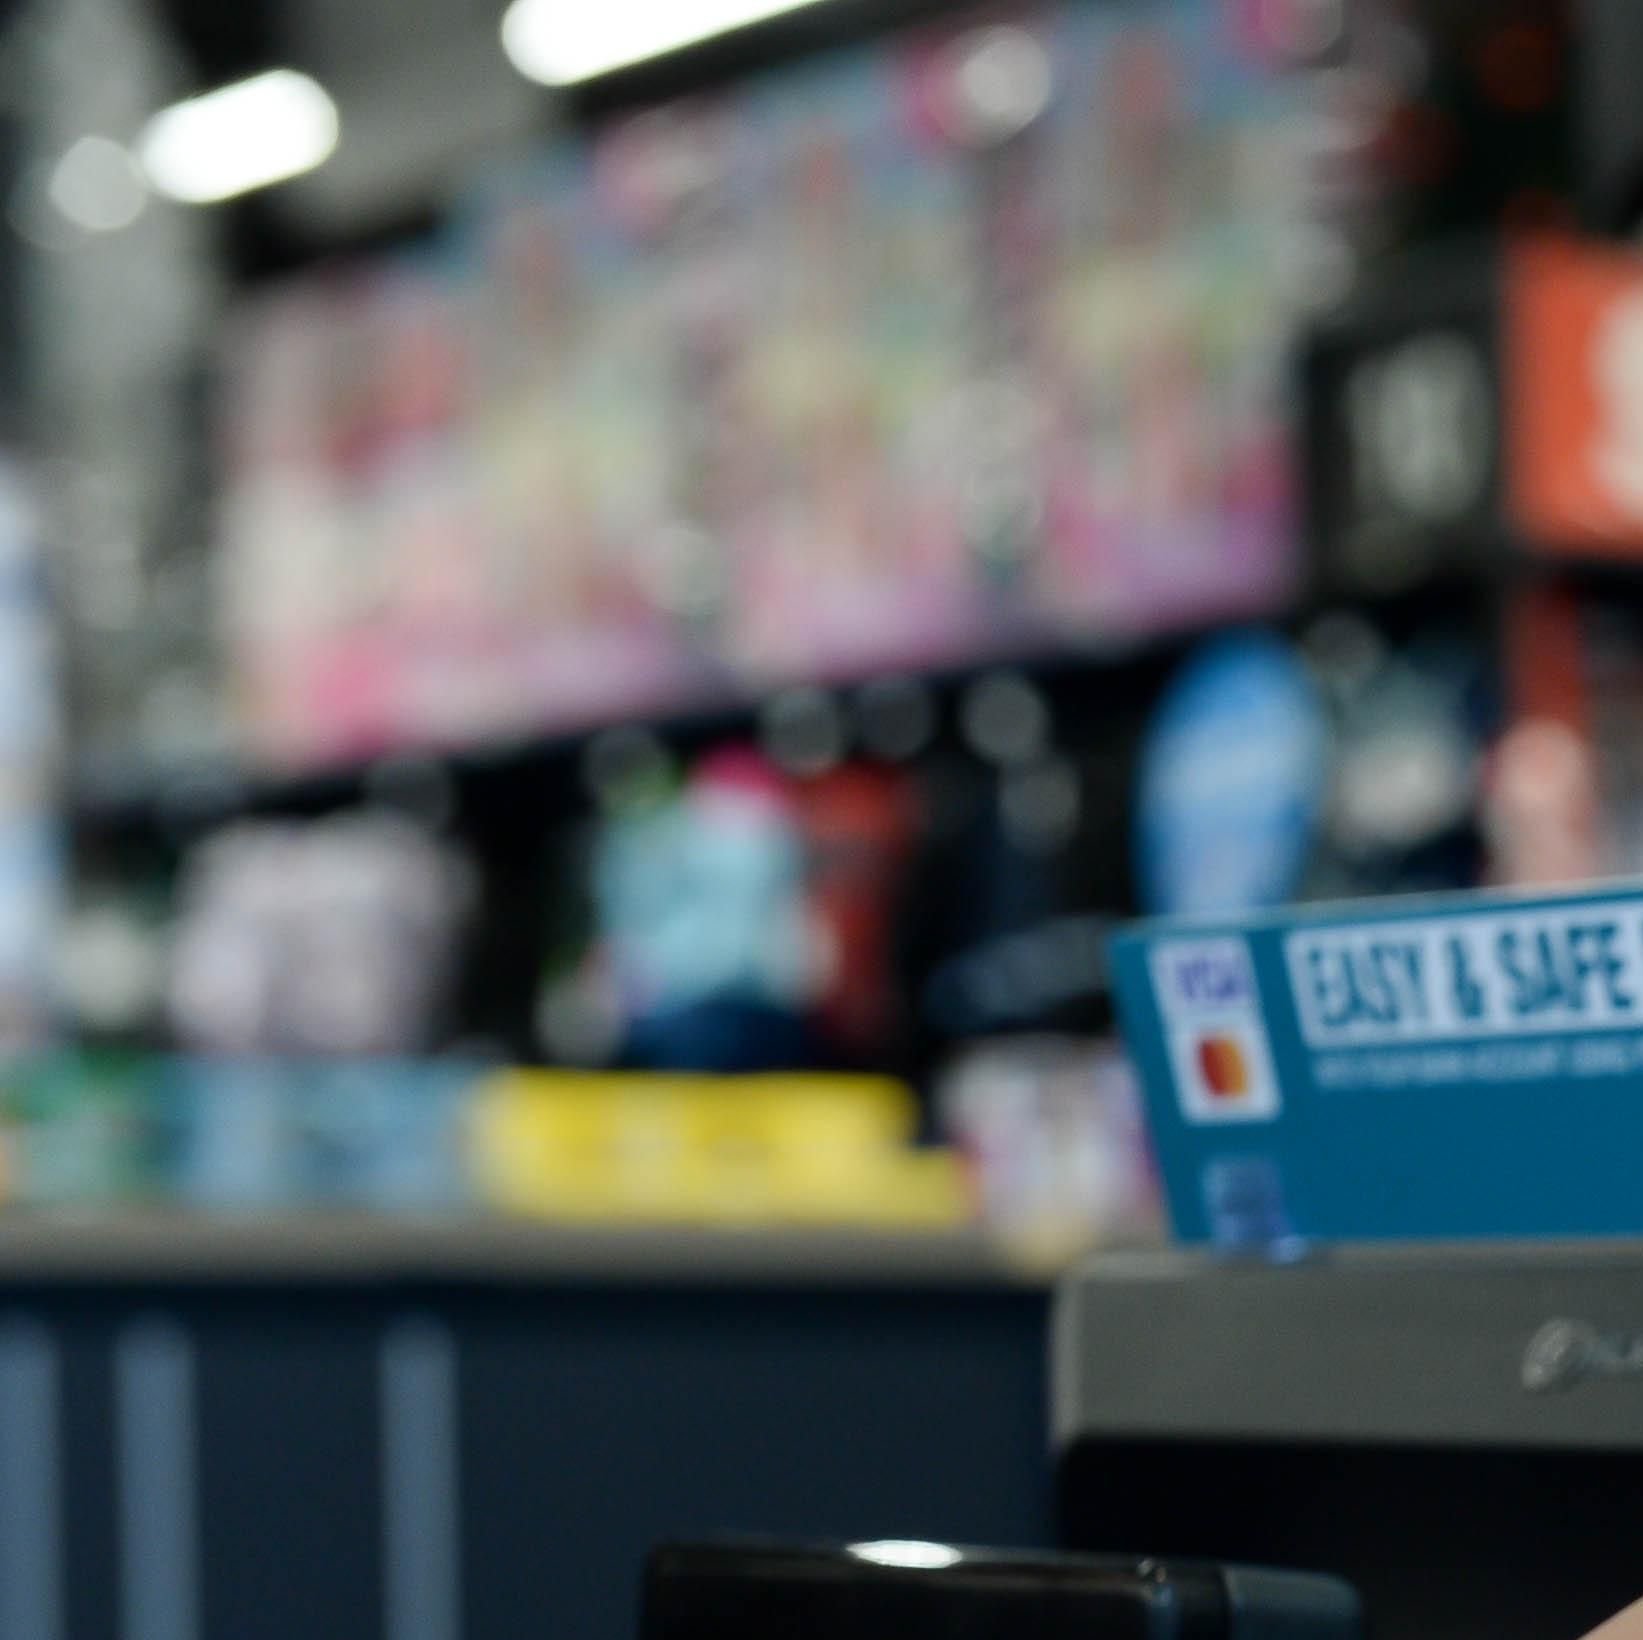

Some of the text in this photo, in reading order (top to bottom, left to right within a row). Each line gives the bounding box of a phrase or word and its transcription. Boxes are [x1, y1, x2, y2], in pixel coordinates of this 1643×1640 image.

[1306, 944, 1428, 1028] EASY
[1447, 934, 1484, 1020] &
[1498, 922, 1634, 1017] SAFE
